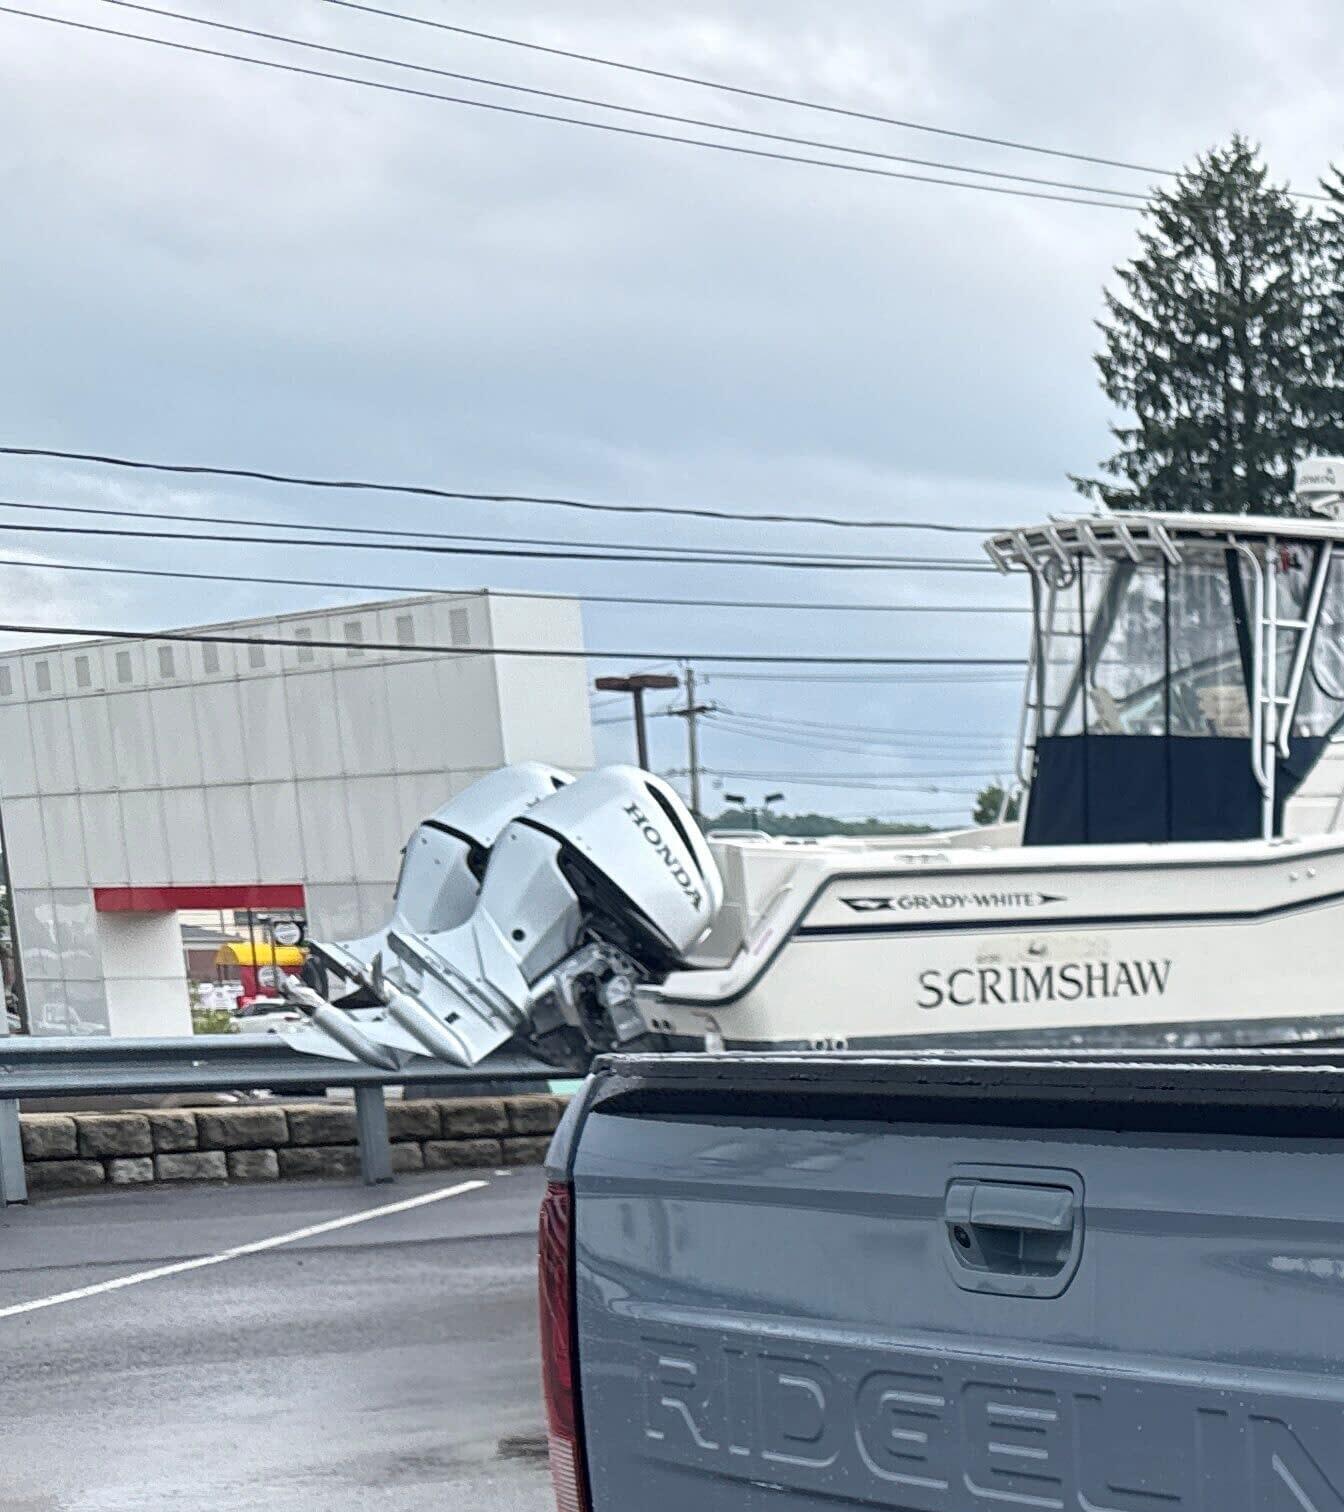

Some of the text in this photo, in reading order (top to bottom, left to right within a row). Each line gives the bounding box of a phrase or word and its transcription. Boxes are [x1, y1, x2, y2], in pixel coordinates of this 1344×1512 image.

[623, 801, 702, 912] HONDA
[900, 892, 1034, 910] GRADY-WHITE
[916, 959, 1172, 1010] SCRIMSHAW
